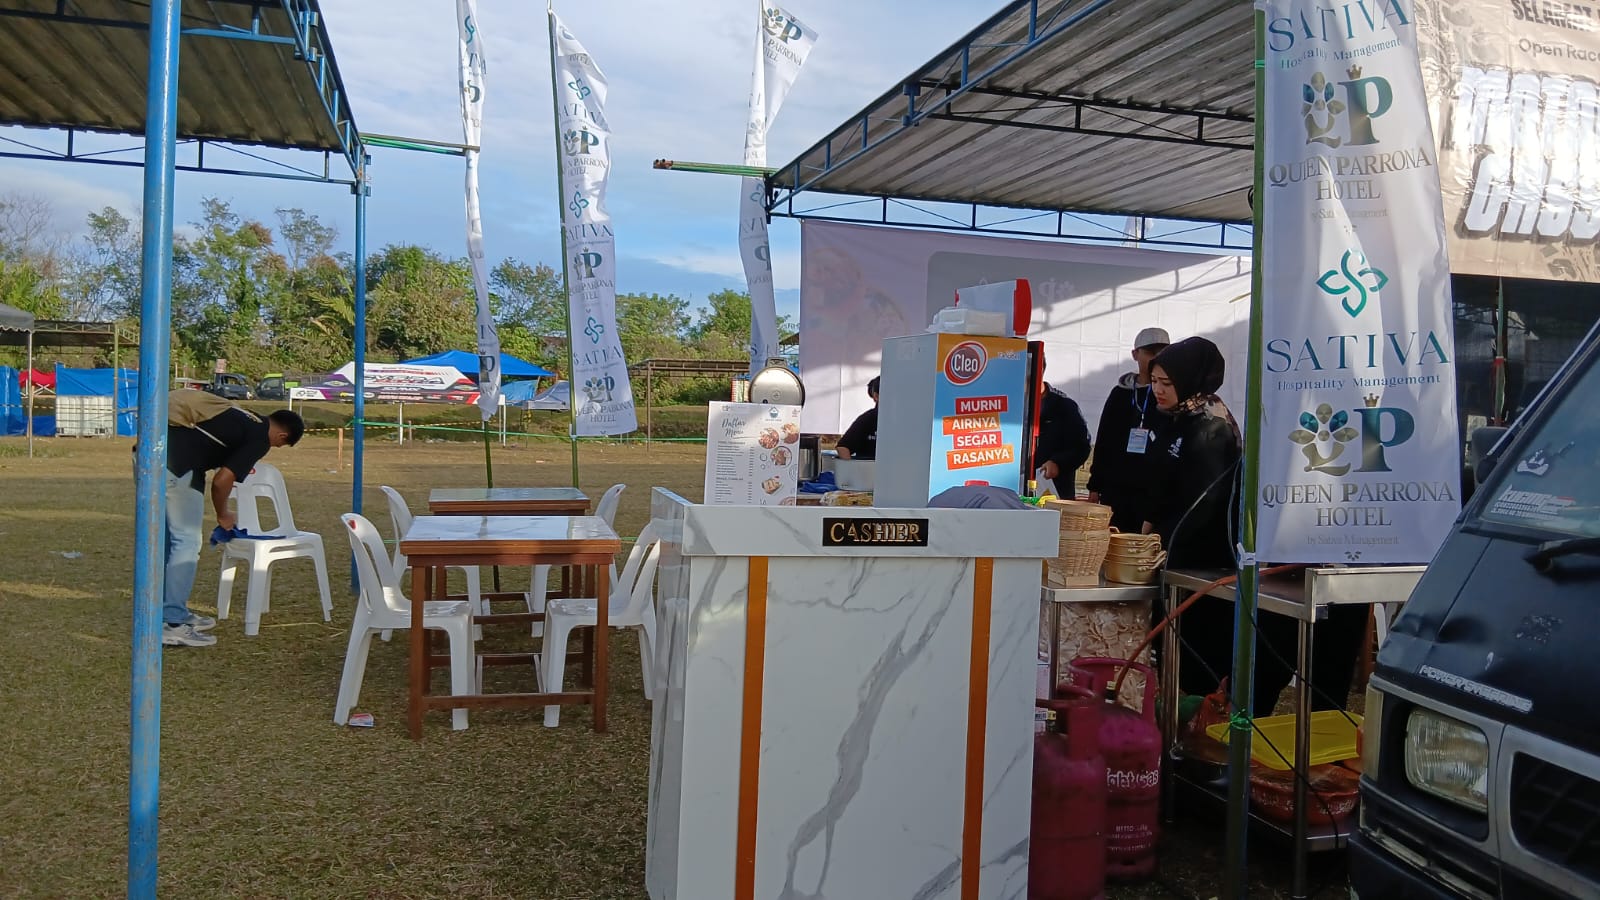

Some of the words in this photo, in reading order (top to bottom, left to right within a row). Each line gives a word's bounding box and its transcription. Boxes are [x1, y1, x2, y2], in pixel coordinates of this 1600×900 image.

[1333, 38, 1401, 61] Management
[1518, 38, 1563, 58] Open
[1336, 147, 1432, 176] PARRONA
[1315, 180, 1381, 201] HOTEL
[1266, 330, 1450, 373] SATIVA
[953, 352, 979, 374] Cleo
[1277, 378, 1345, 392] Hospitality
[1352, 374, 1441, 389] Management
[960, 399, 1002, 413] MURNI
[952, 416, 999, 430] AIRNYA
[956, 433, 998, 447] SEGAR
[953, 448, 1010, 465] RASANYA
[1262, 483, 1332, 507] QUEEN
[1340, 481, 1455, 502] PARRONA
[1315, 506, 1393, 527] HOTEL
[830, 522, 923, 542] CASHIER
